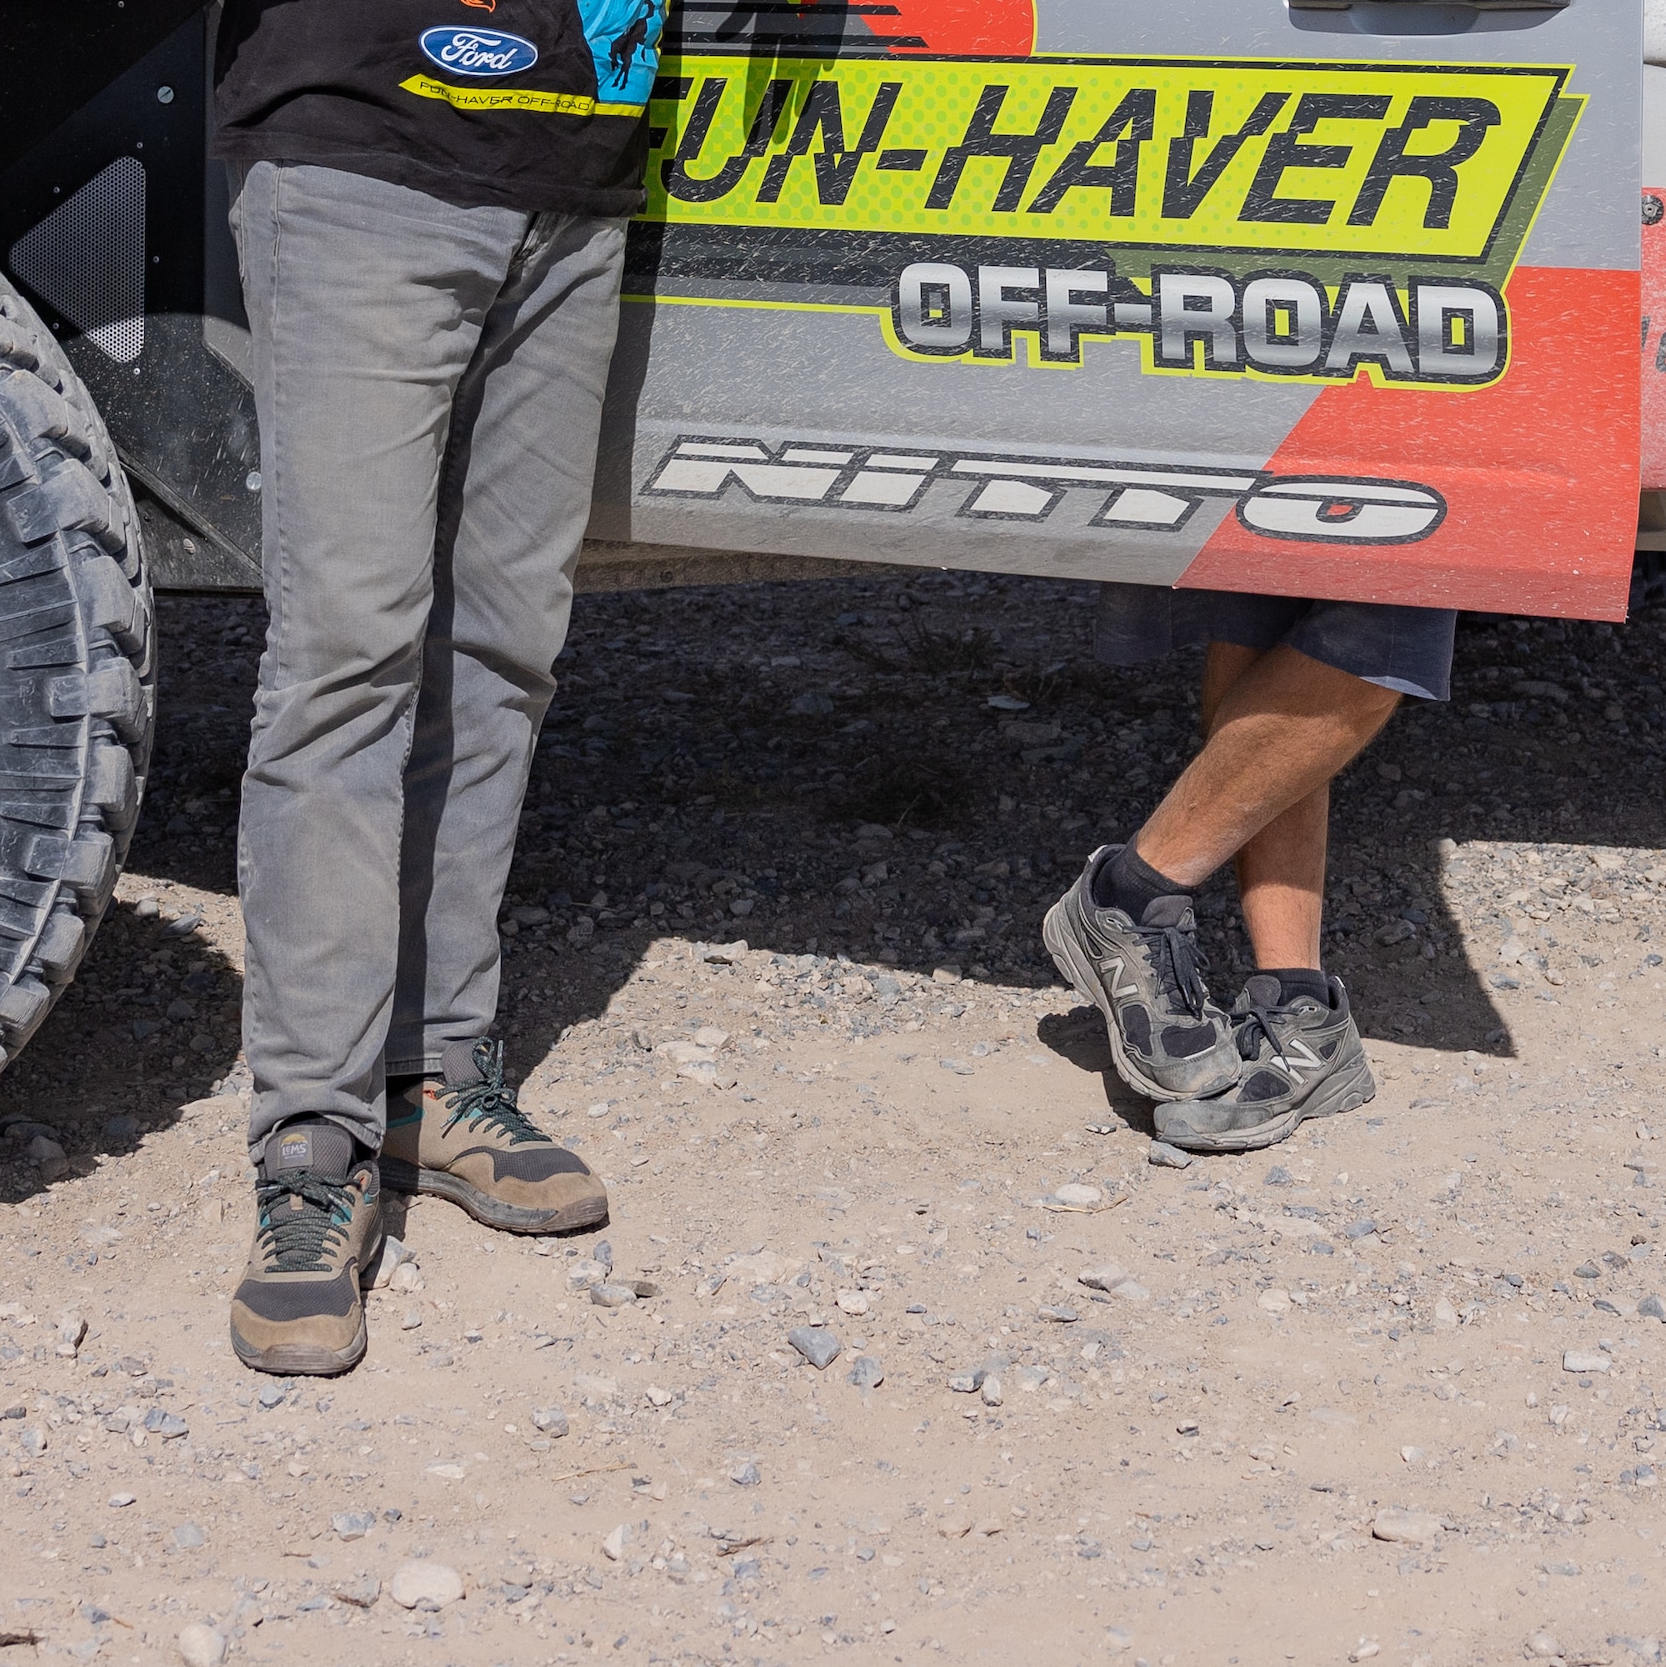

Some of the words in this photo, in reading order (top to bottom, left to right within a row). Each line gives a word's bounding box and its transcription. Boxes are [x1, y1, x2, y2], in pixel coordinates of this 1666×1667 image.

[441, 33, 518, 70] Ford
[419, 81, 514, 106] FUN-HAVER
[517, 95, 592, 112] OFF-ROAD
[895, 260, 1509, 385] OFF-ROAD
[640, 434, 1446, 545] NITTO
